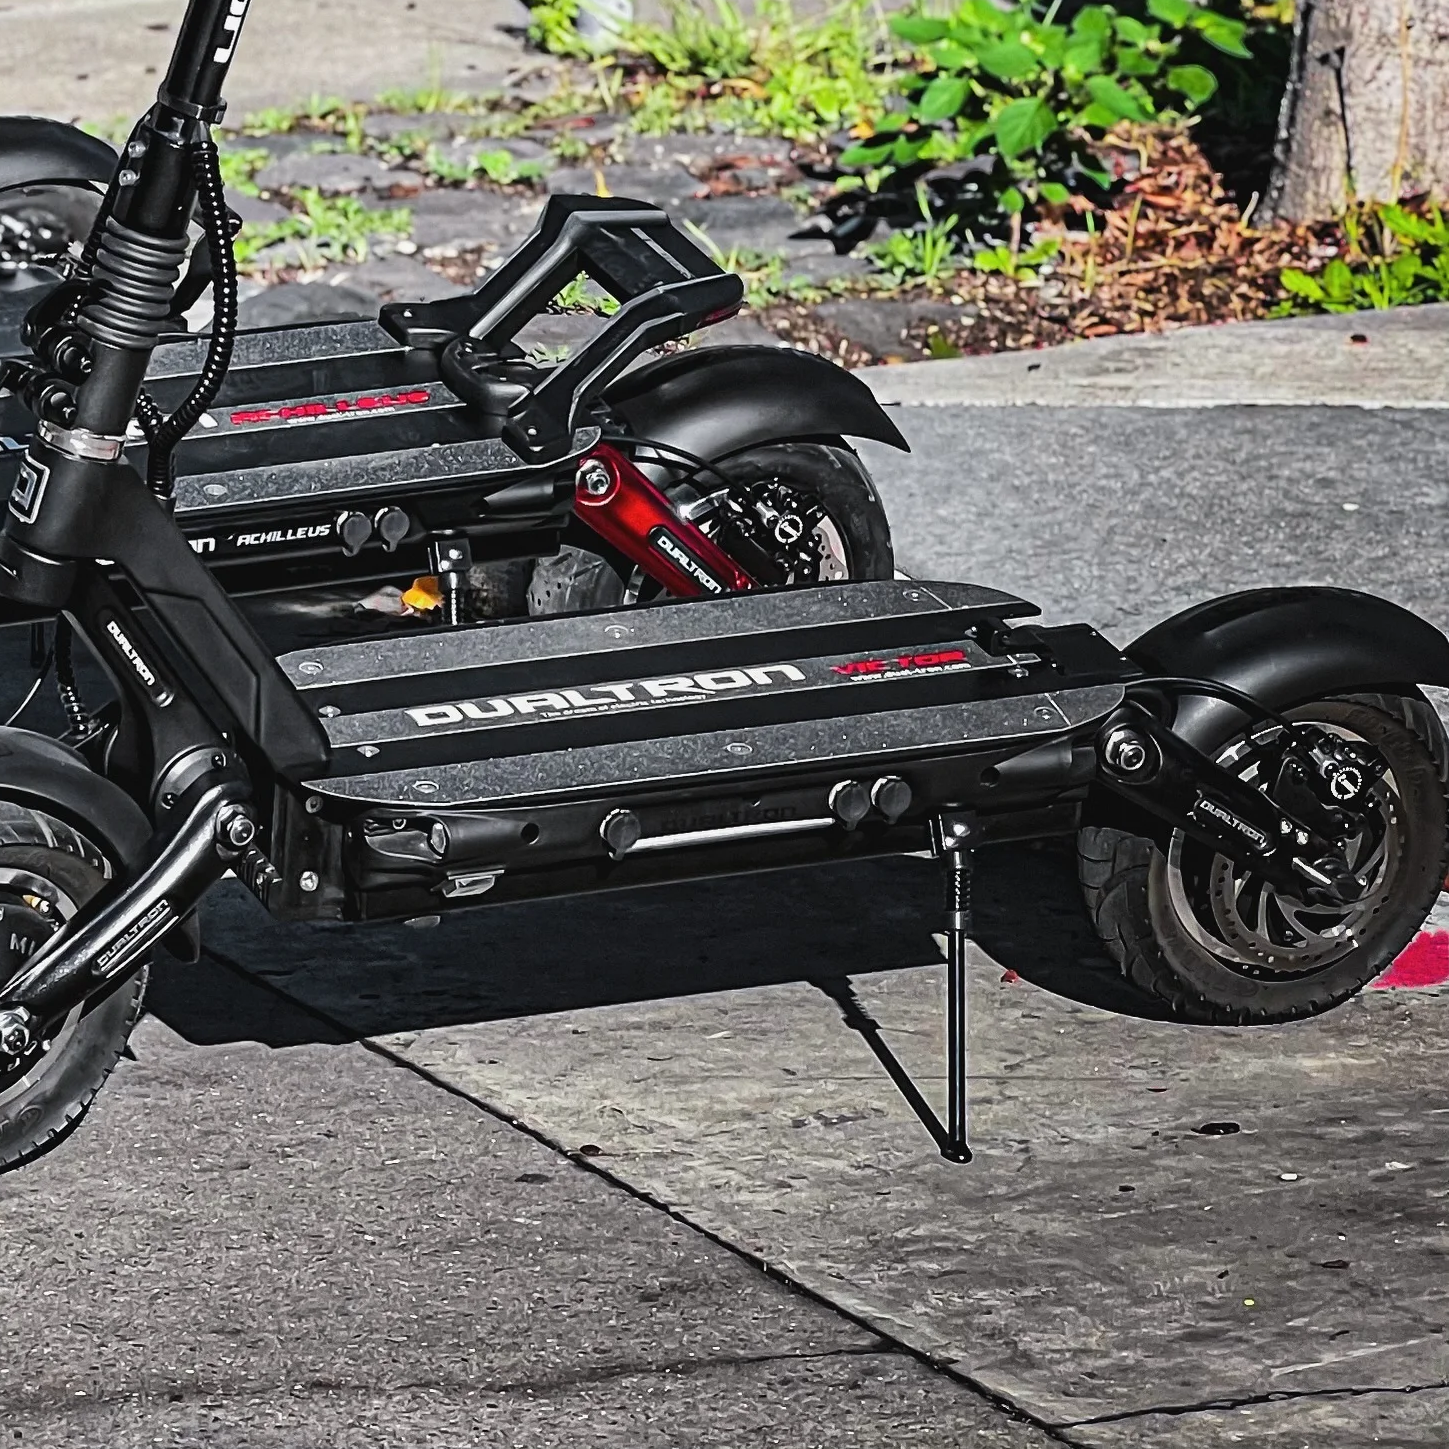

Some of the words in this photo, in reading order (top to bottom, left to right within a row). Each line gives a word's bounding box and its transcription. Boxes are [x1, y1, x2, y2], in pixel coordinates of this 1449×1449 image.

[237, 525, 331, 546] ACHILLEUS
[657, 535, 722, 594] DUALTRON
[107, 621, 155, 685] DUALTRON
[404, 664, 807, 726] DUALTRON
[96, 899, 169, 968] DUALTRON
